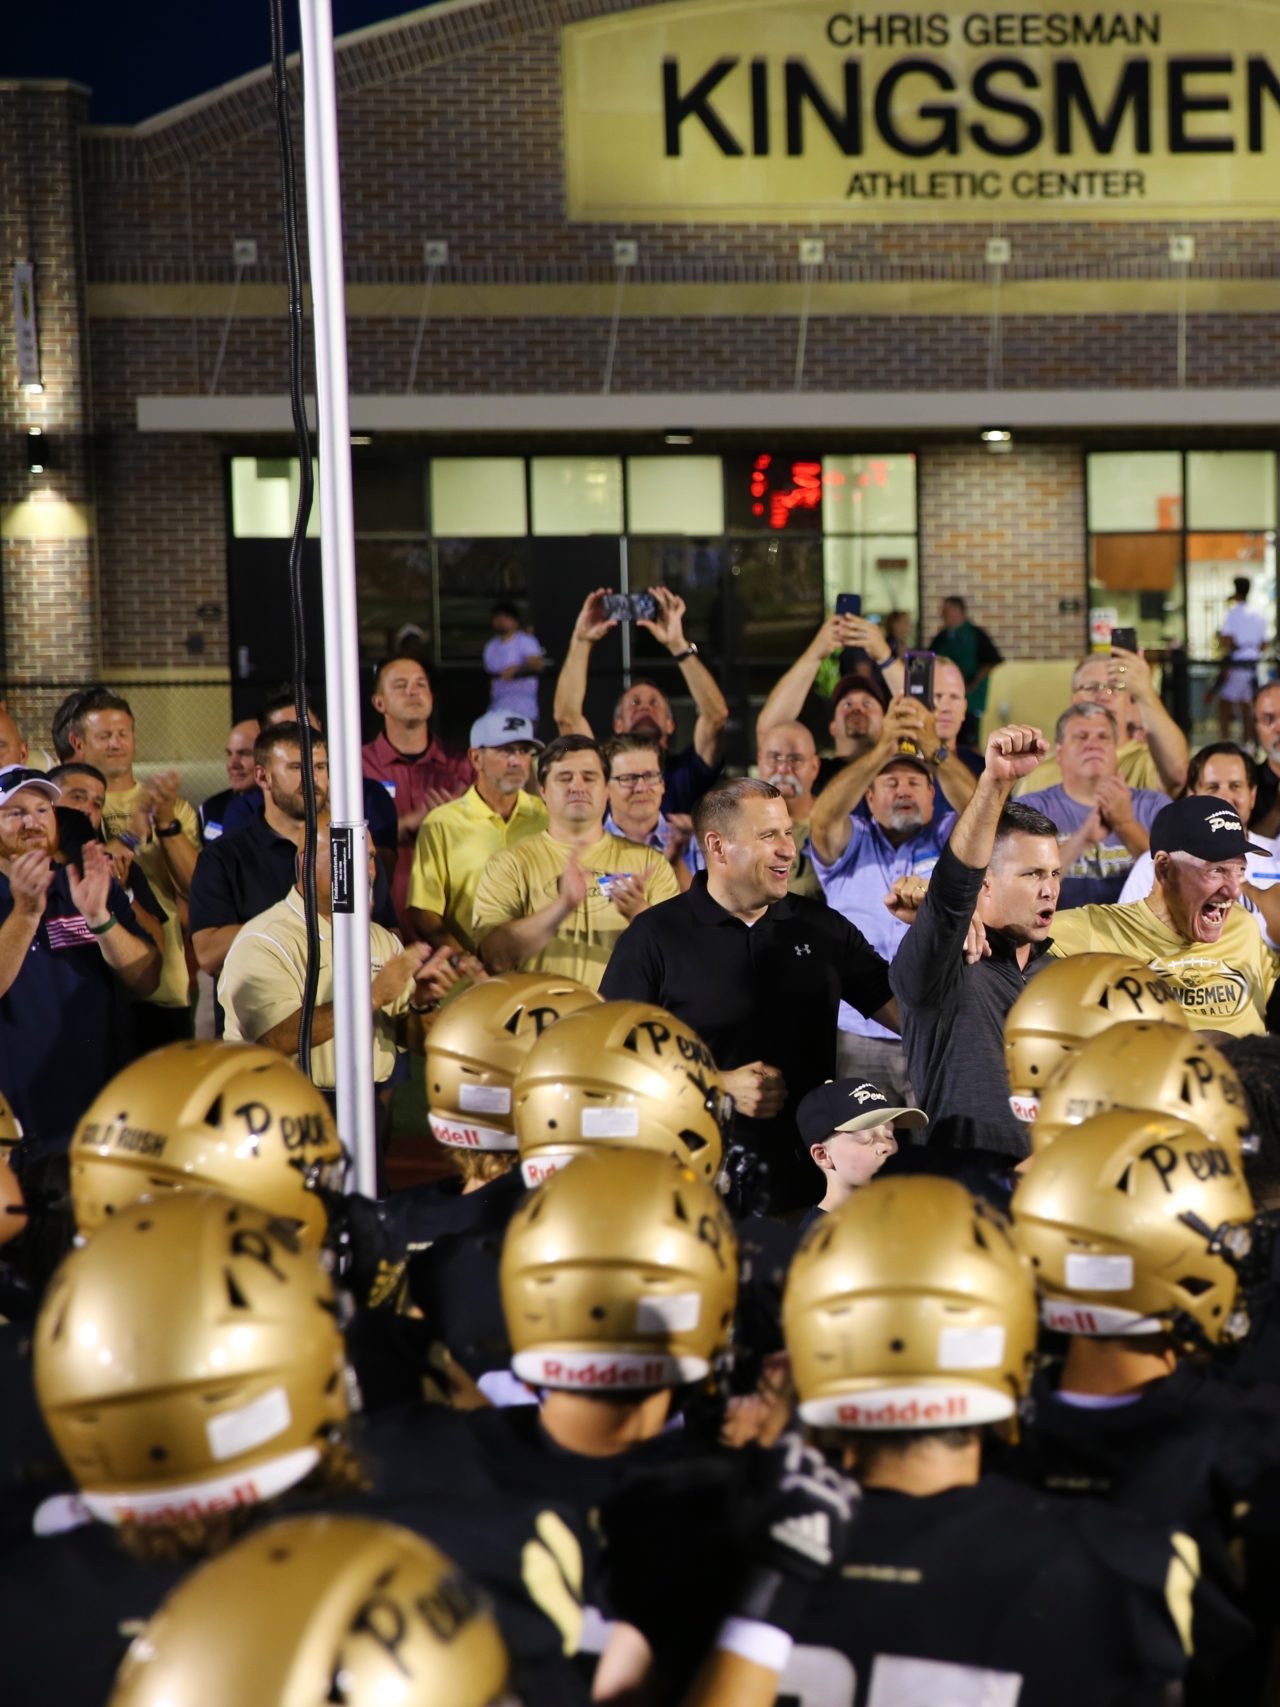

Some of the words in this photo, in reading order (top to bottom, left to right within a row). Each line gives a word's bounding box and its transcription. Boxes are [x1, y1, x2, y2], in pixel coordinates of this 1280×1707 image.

[826, 13, 949, 47] CHRIS
[963, 12, 1160, 46] GEESMAN
[846, 169, 1001, 200] ATHLETIC
[1011, 168, 1145, 199] CENTER
[503, 716, 526, 732] P
[1173, 984, 1237, 1006] NGSMEN
[543, 1360, 663, 1386] Riddell
[837, 1397, 968, 1425] Riddell
